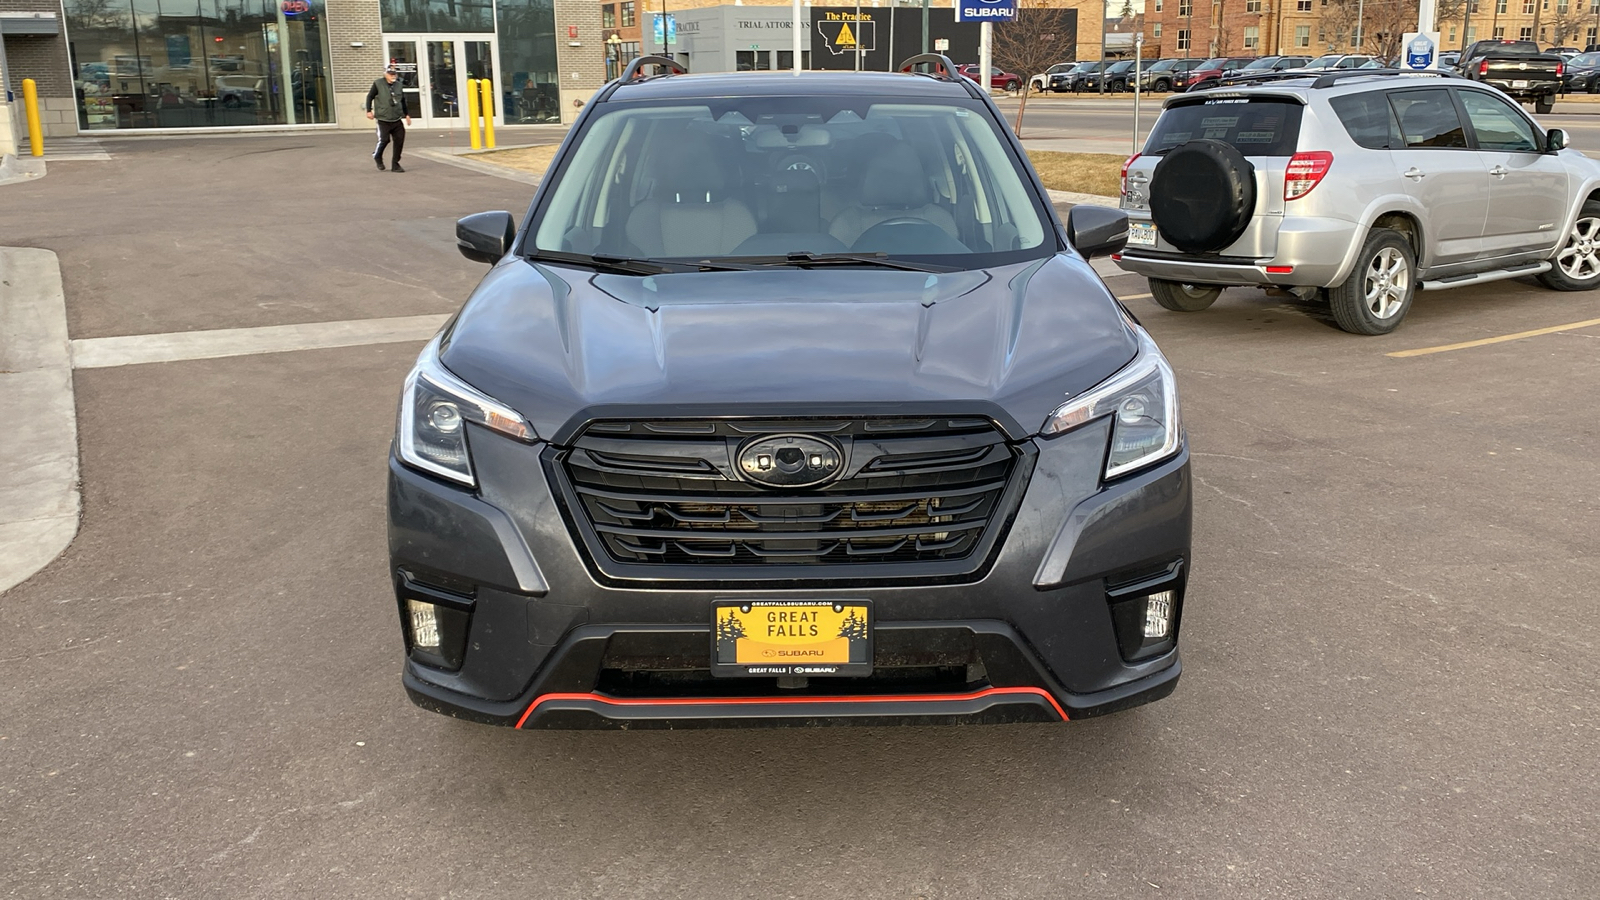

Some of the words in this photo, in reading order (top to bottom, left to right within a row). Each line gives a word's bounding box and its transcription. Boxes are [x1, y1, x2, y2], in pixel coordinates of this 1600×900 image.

[281, 1, 309, 12] OPEN
[825, 12, 840, 20] The
[964, 8, 1014, 17] SUBARU
[676, 22, 699, 32] PRACTICE
[738, 21, 763, 29] TRIAL
[767, 611, 818, 623] GREAT
[767, 624, 818, 637] FALLS
